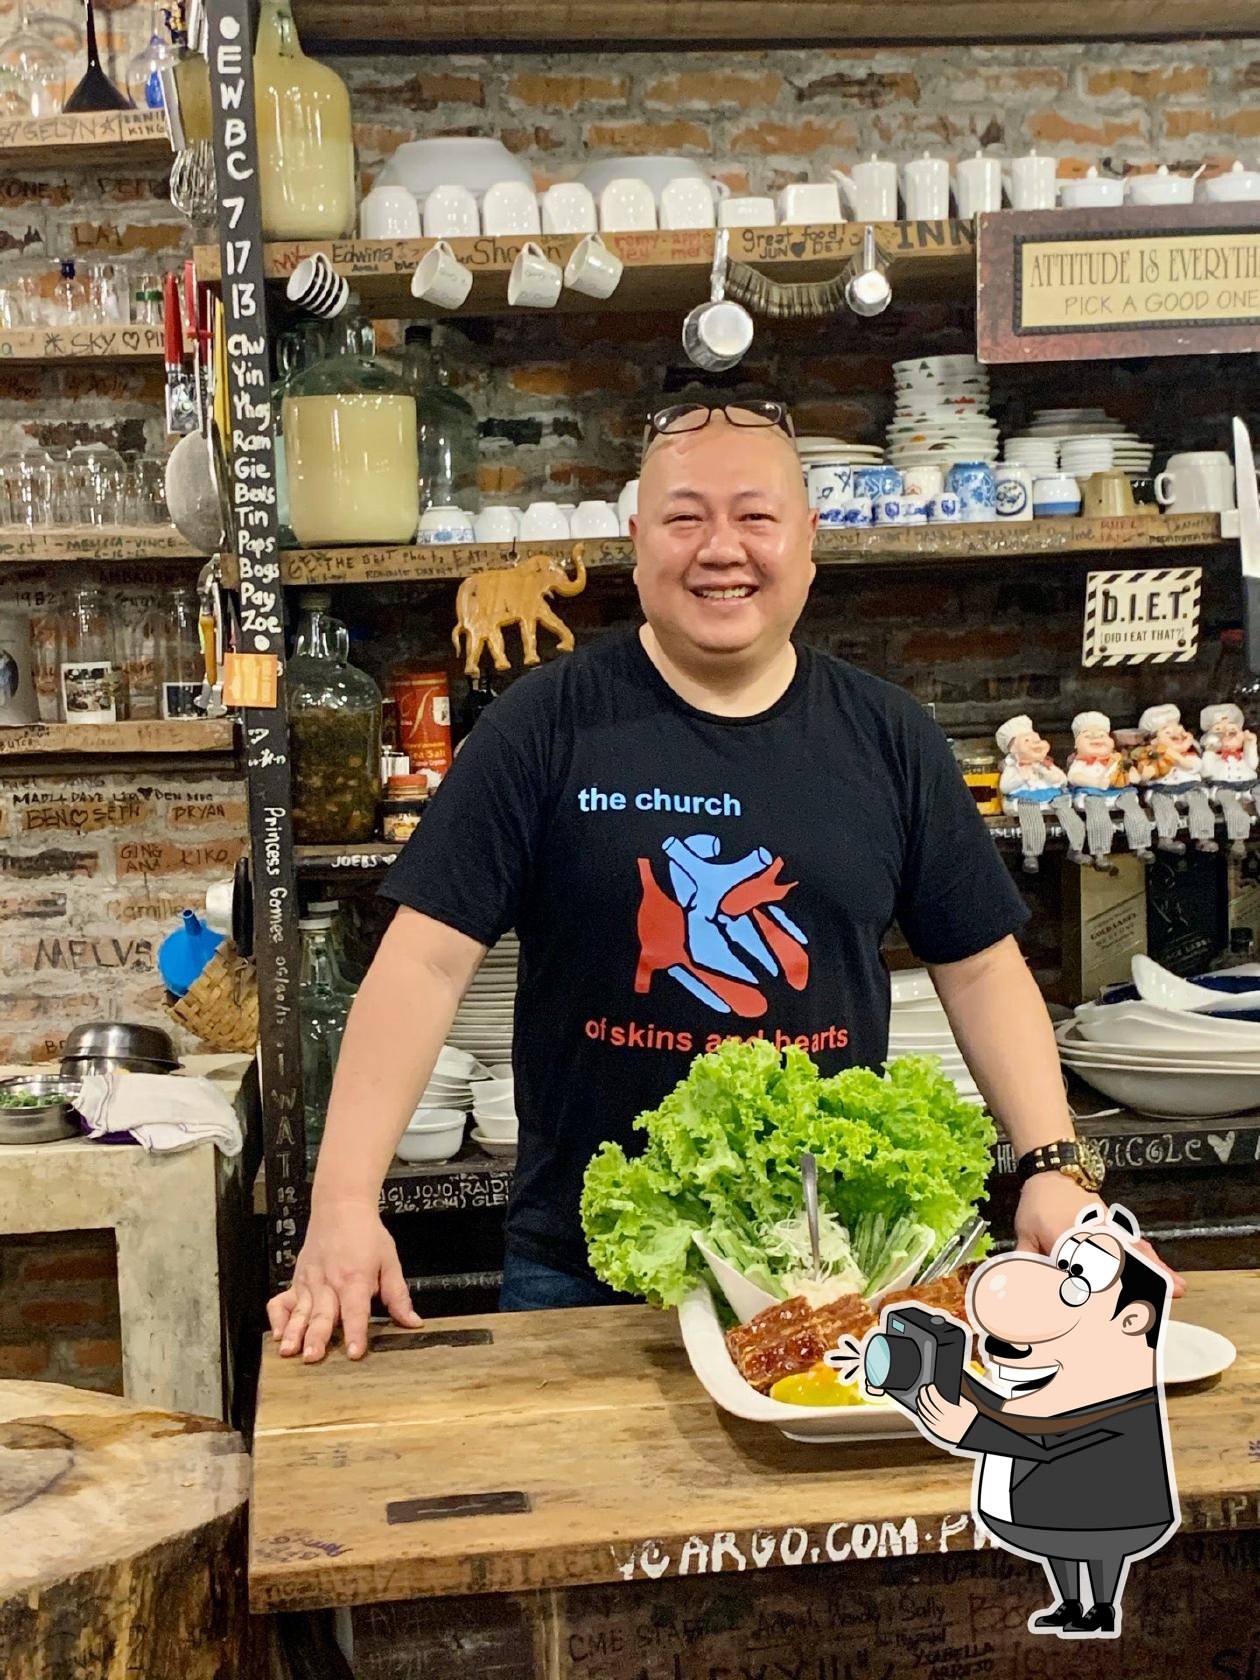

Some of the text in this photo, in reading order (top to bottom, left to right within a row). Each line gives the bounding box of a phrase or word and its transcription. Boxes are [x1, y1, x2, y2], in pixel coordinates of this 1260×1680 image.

[222, 196, 245, 230] 7
[226, 240, 251, 275] 17
[1030, 246, 1260, 288] ATTITUDE IS EVERYTH
[231, 283, 257, 319] 13
[1064, 295, 1113, 316] PICK
[1122, 294, 1137, 313] A
[1145, 290, 1209, 313] GOOD
[231, 360, 265, 388] Yin
[234, 505, 268, 528] Tin
[240, 610, 281, 635] Zoe
[1101, 591, 1188, 624] D.I.E.T.
[1130, 630, 1147, 643] EAT
[172, 804, 226, 821] BRYAN
[577, 786, 742, 817] the church
[26, 804, 141, 831] BEN SETH
[262, 806, 287, 877] Princess
[585, 1017, 607, 1042] of
[610, 1021, 693, 1052] skins
